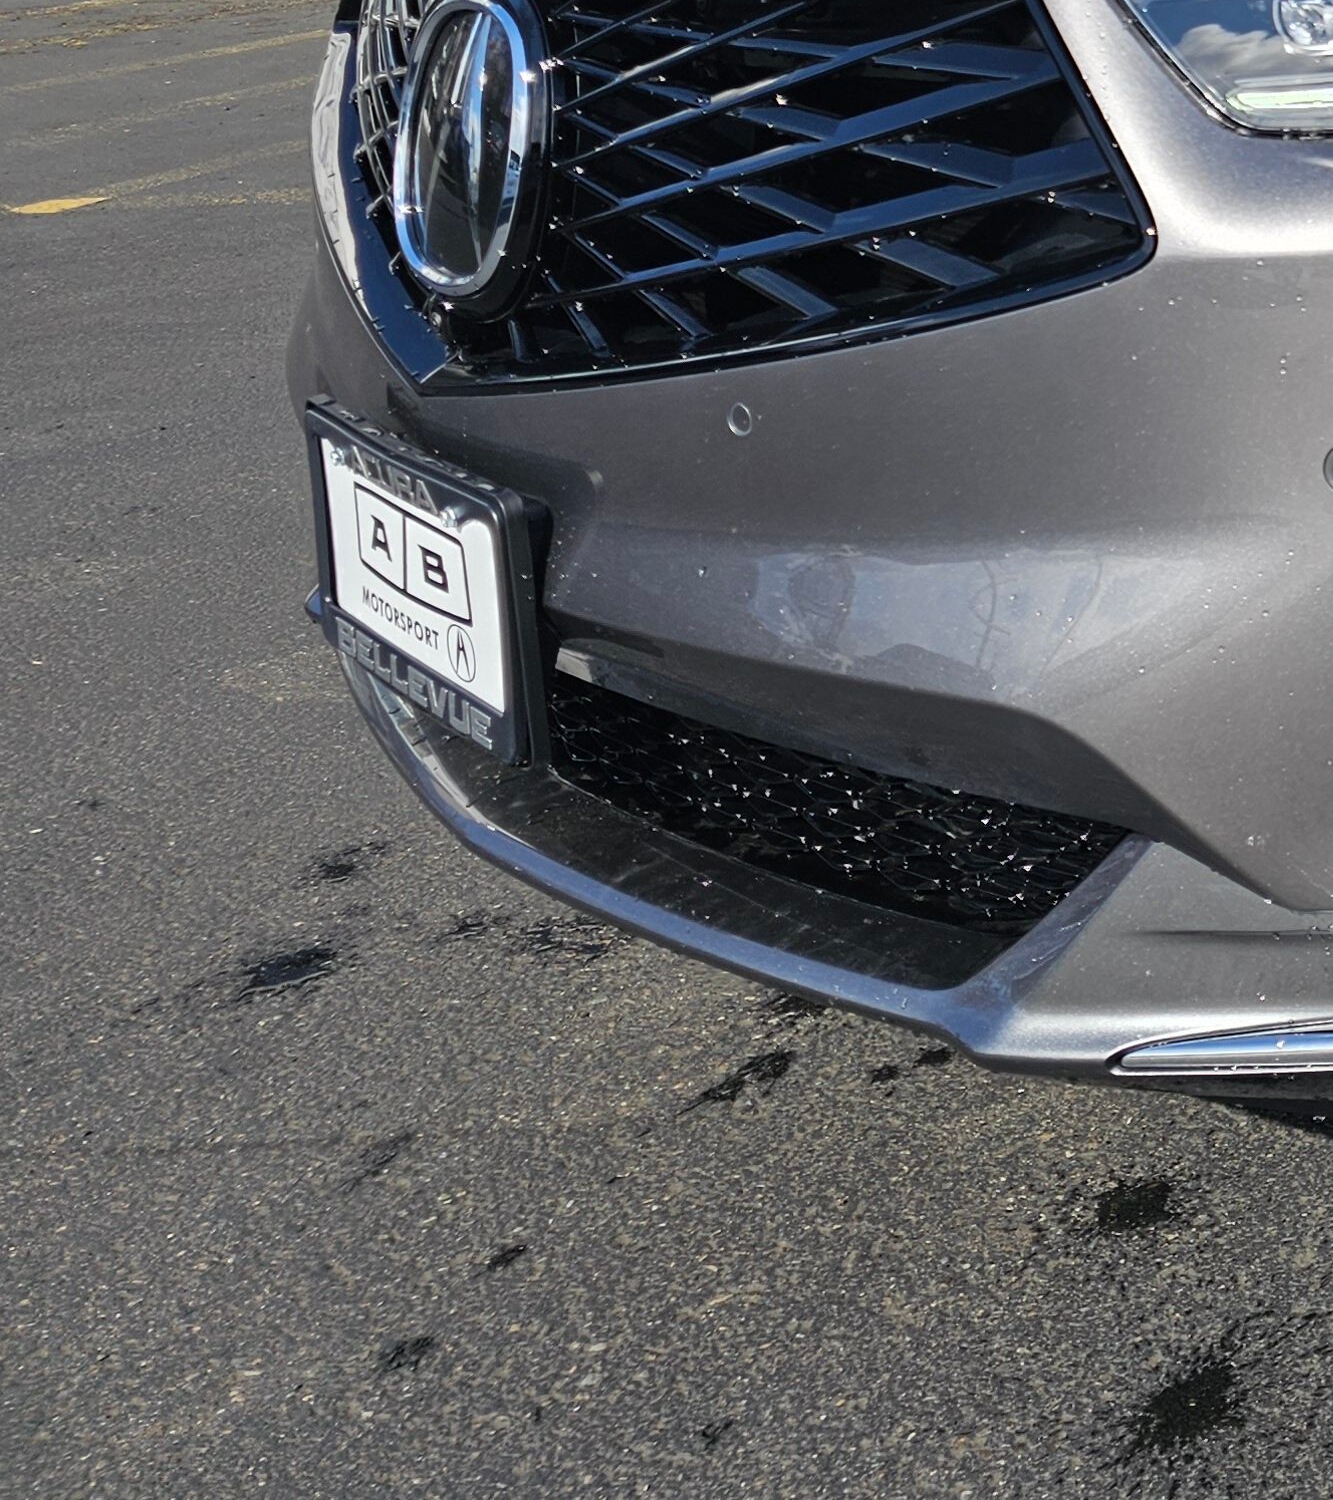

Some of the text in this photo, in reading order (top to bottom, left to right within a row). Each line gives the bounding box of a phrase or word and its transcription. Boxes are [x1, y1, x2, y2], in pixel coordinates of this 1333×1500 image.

[351, 445, 439, 516] ACURA
[370, 514, 450, 596] A B
[362, 585, 440, 651] MOTORSPORT
[336, 616, 493, 751] BELLEVUE
